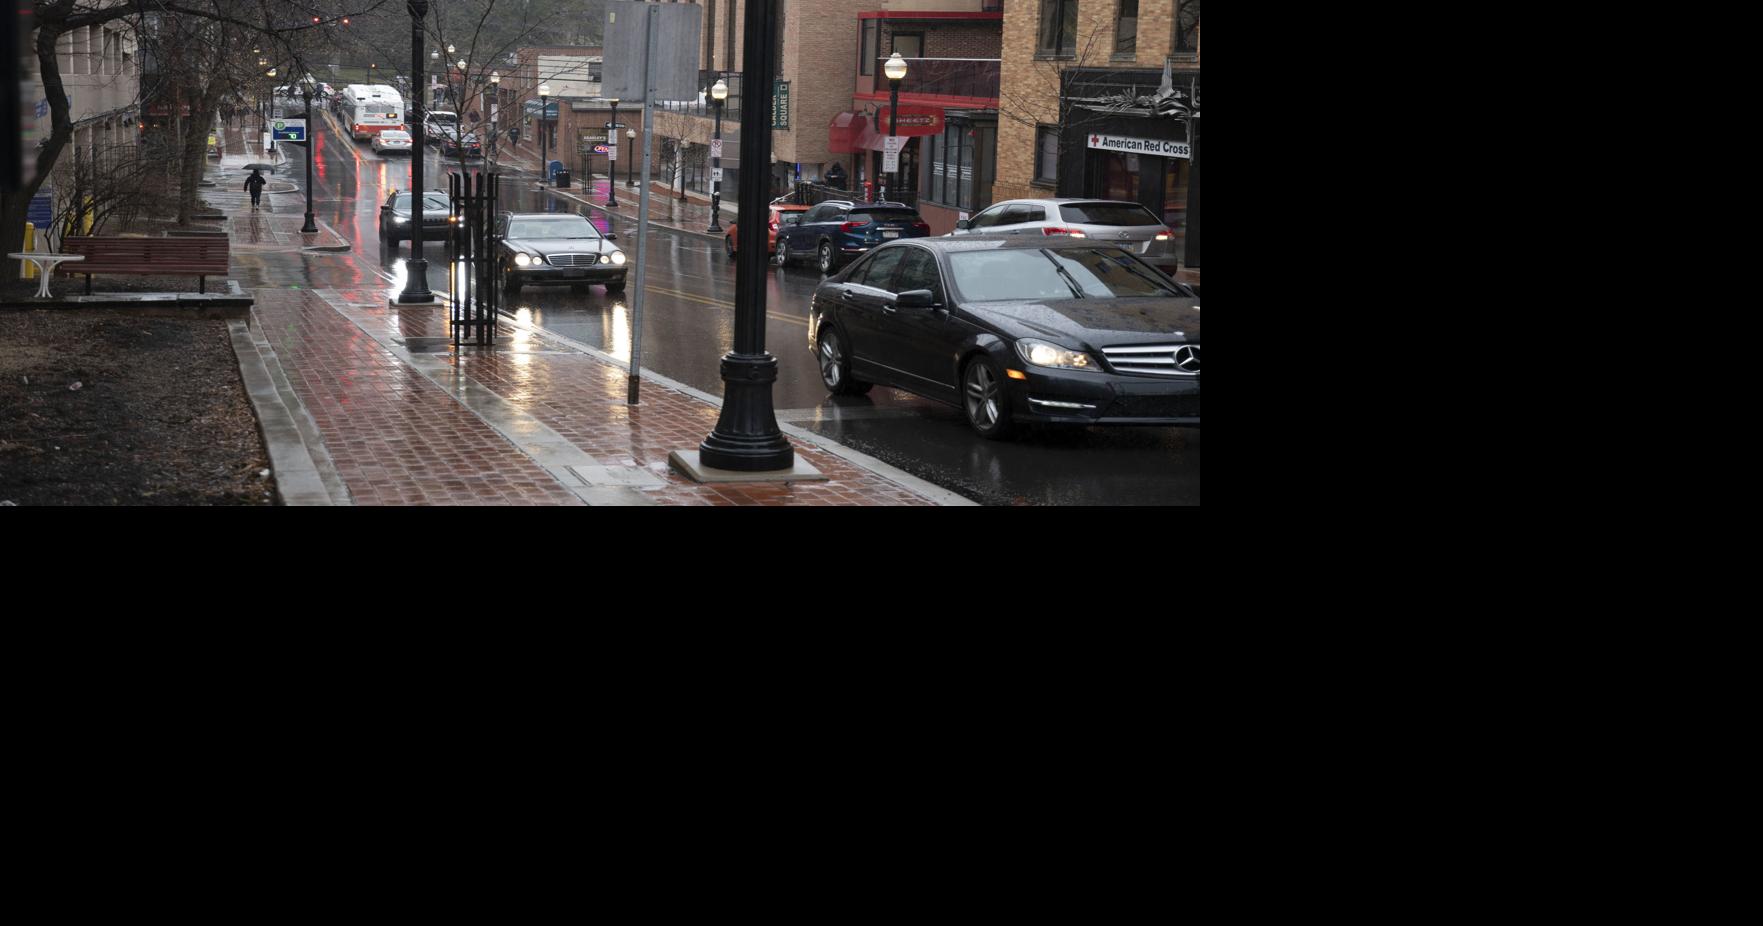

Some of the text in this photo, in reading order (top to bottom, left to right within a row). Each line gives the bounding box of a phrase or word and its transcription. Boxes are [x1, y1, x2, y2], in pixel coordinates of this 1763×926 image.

[780, 94, 788, 126] SQUARE
[1102, 136, 1188, 155] American Red Cross
